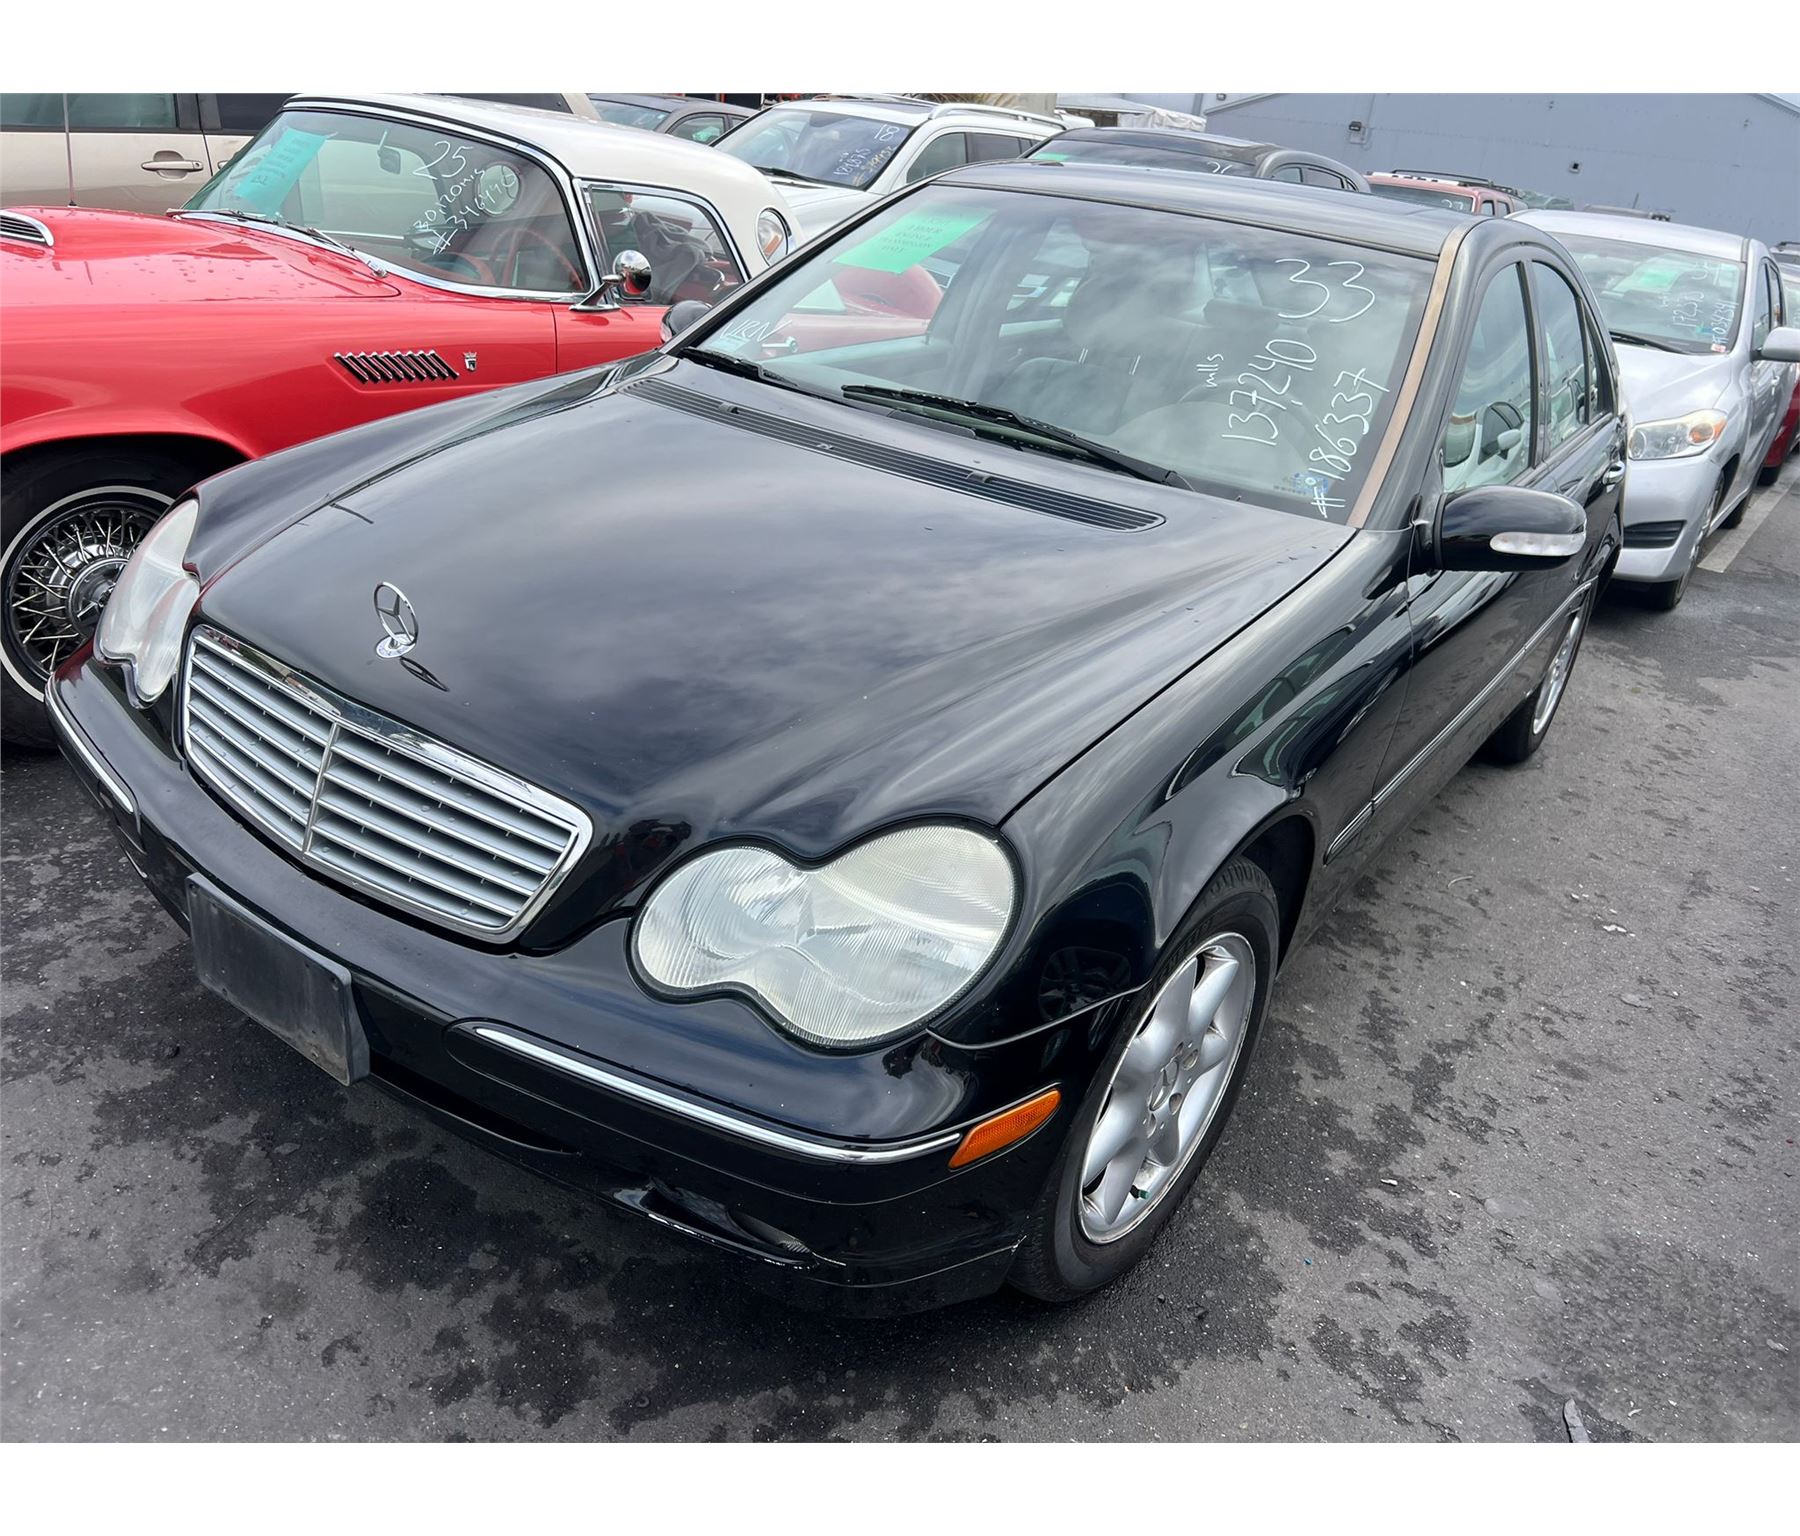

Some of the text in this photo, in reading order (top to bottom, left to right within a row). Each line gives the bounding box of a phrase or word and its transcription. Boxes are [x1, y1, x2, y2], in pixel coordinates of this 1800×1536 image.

[412, 140, 474, 180] 25
[873, 124, 900, 142] 18
[1275, 257, 1376, 324] 33
[1221, 338, 1317, 447] 137,240
[1310, 367, 1391, 519] #186337
